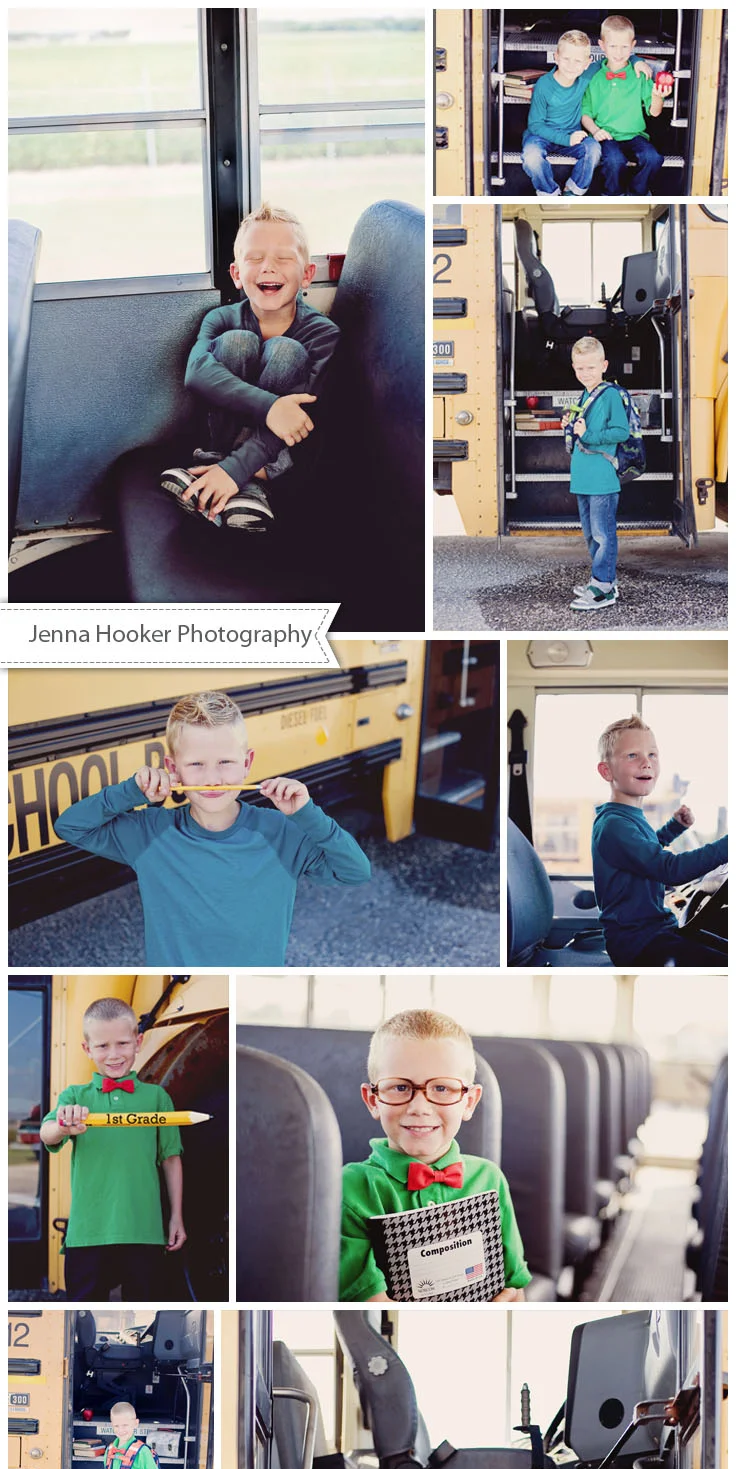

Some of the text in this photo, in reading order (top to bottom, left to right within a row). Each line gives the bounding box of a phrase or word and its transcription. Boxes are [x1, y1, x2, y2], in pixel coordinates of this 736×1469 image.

[280, 705, 327, 730] DIESEL FUEL
[106, 1113, 167, 1124] 1st Grade
[420, 1238, 472, 1258] Composition
